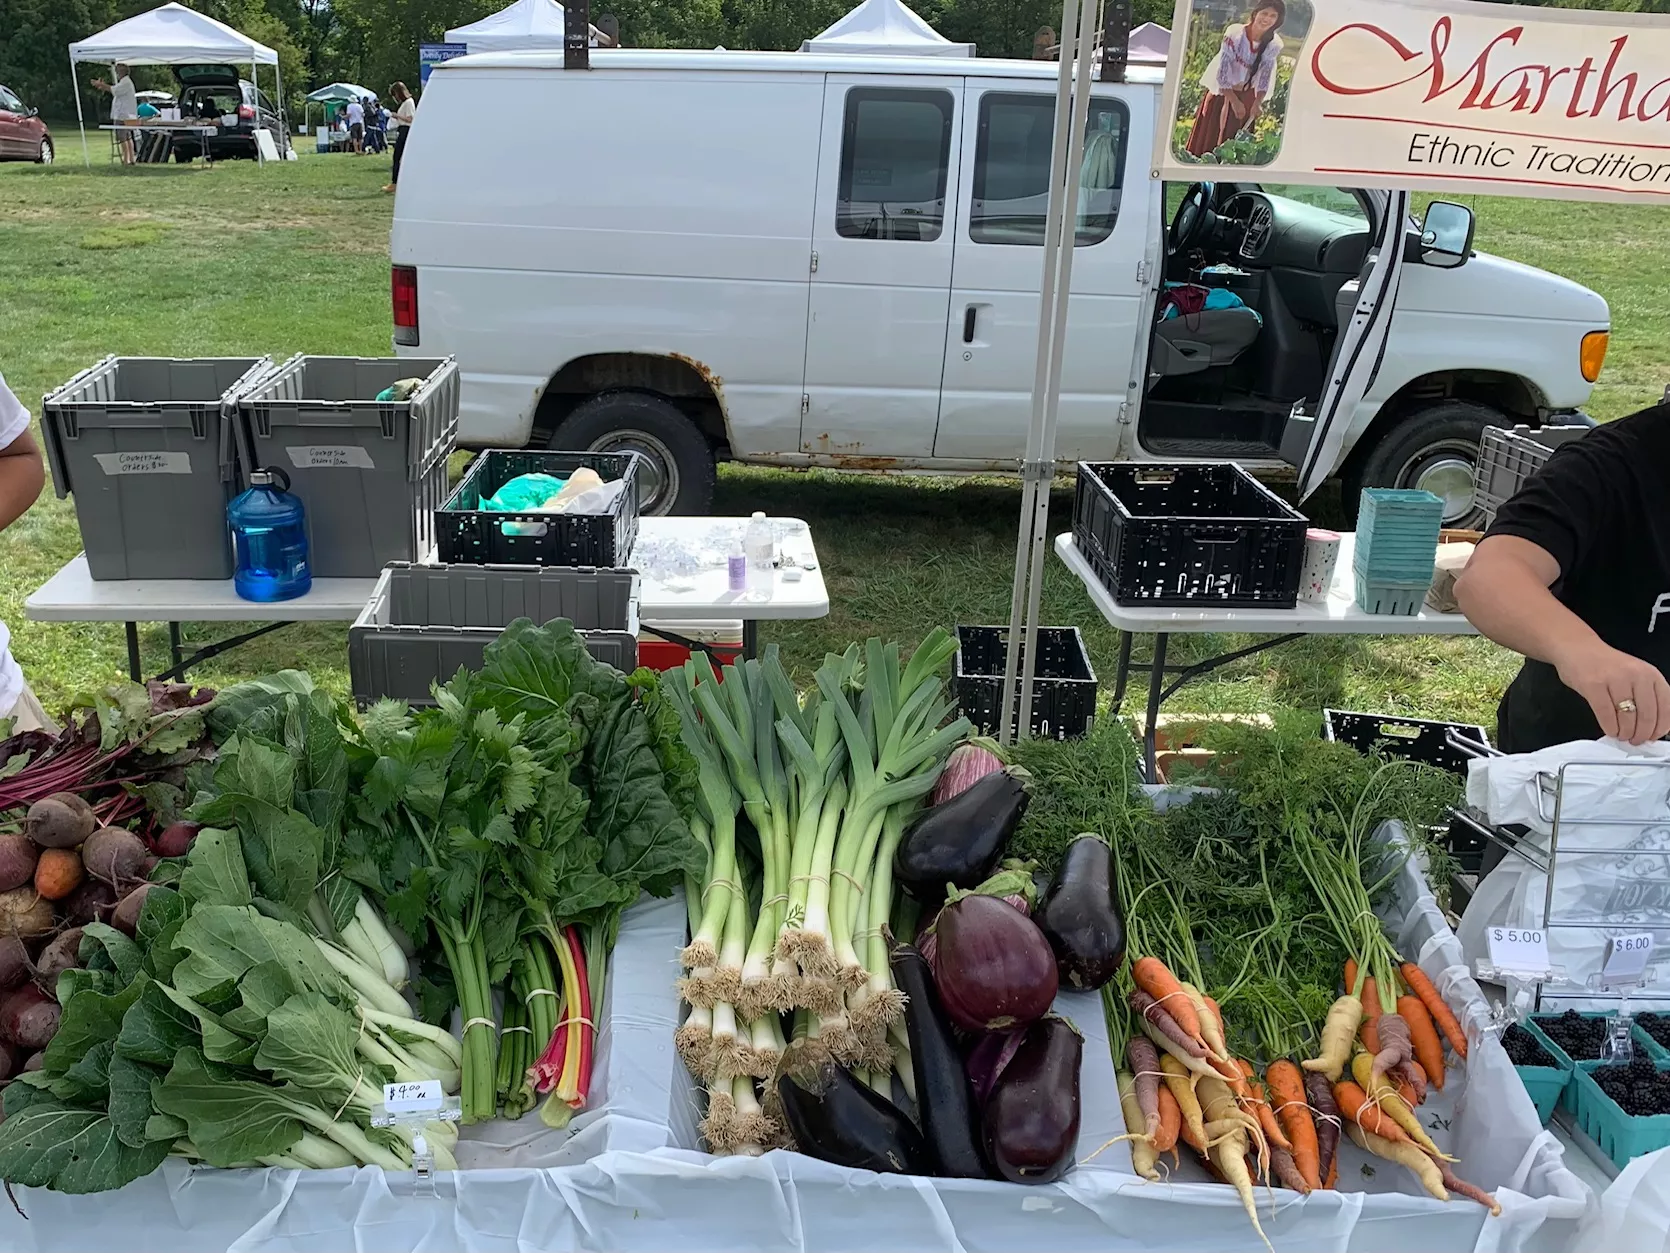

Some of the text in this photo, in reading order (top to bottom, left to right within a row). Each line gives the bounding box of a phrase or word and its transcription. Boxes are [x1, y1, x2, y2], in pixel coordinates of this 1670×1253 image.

[1407, 133, 1670, 182] Ethnic Tradition
[1508, 930, 1541, 943] 5.00
[1626, 937, 1649, 950] 6.00
